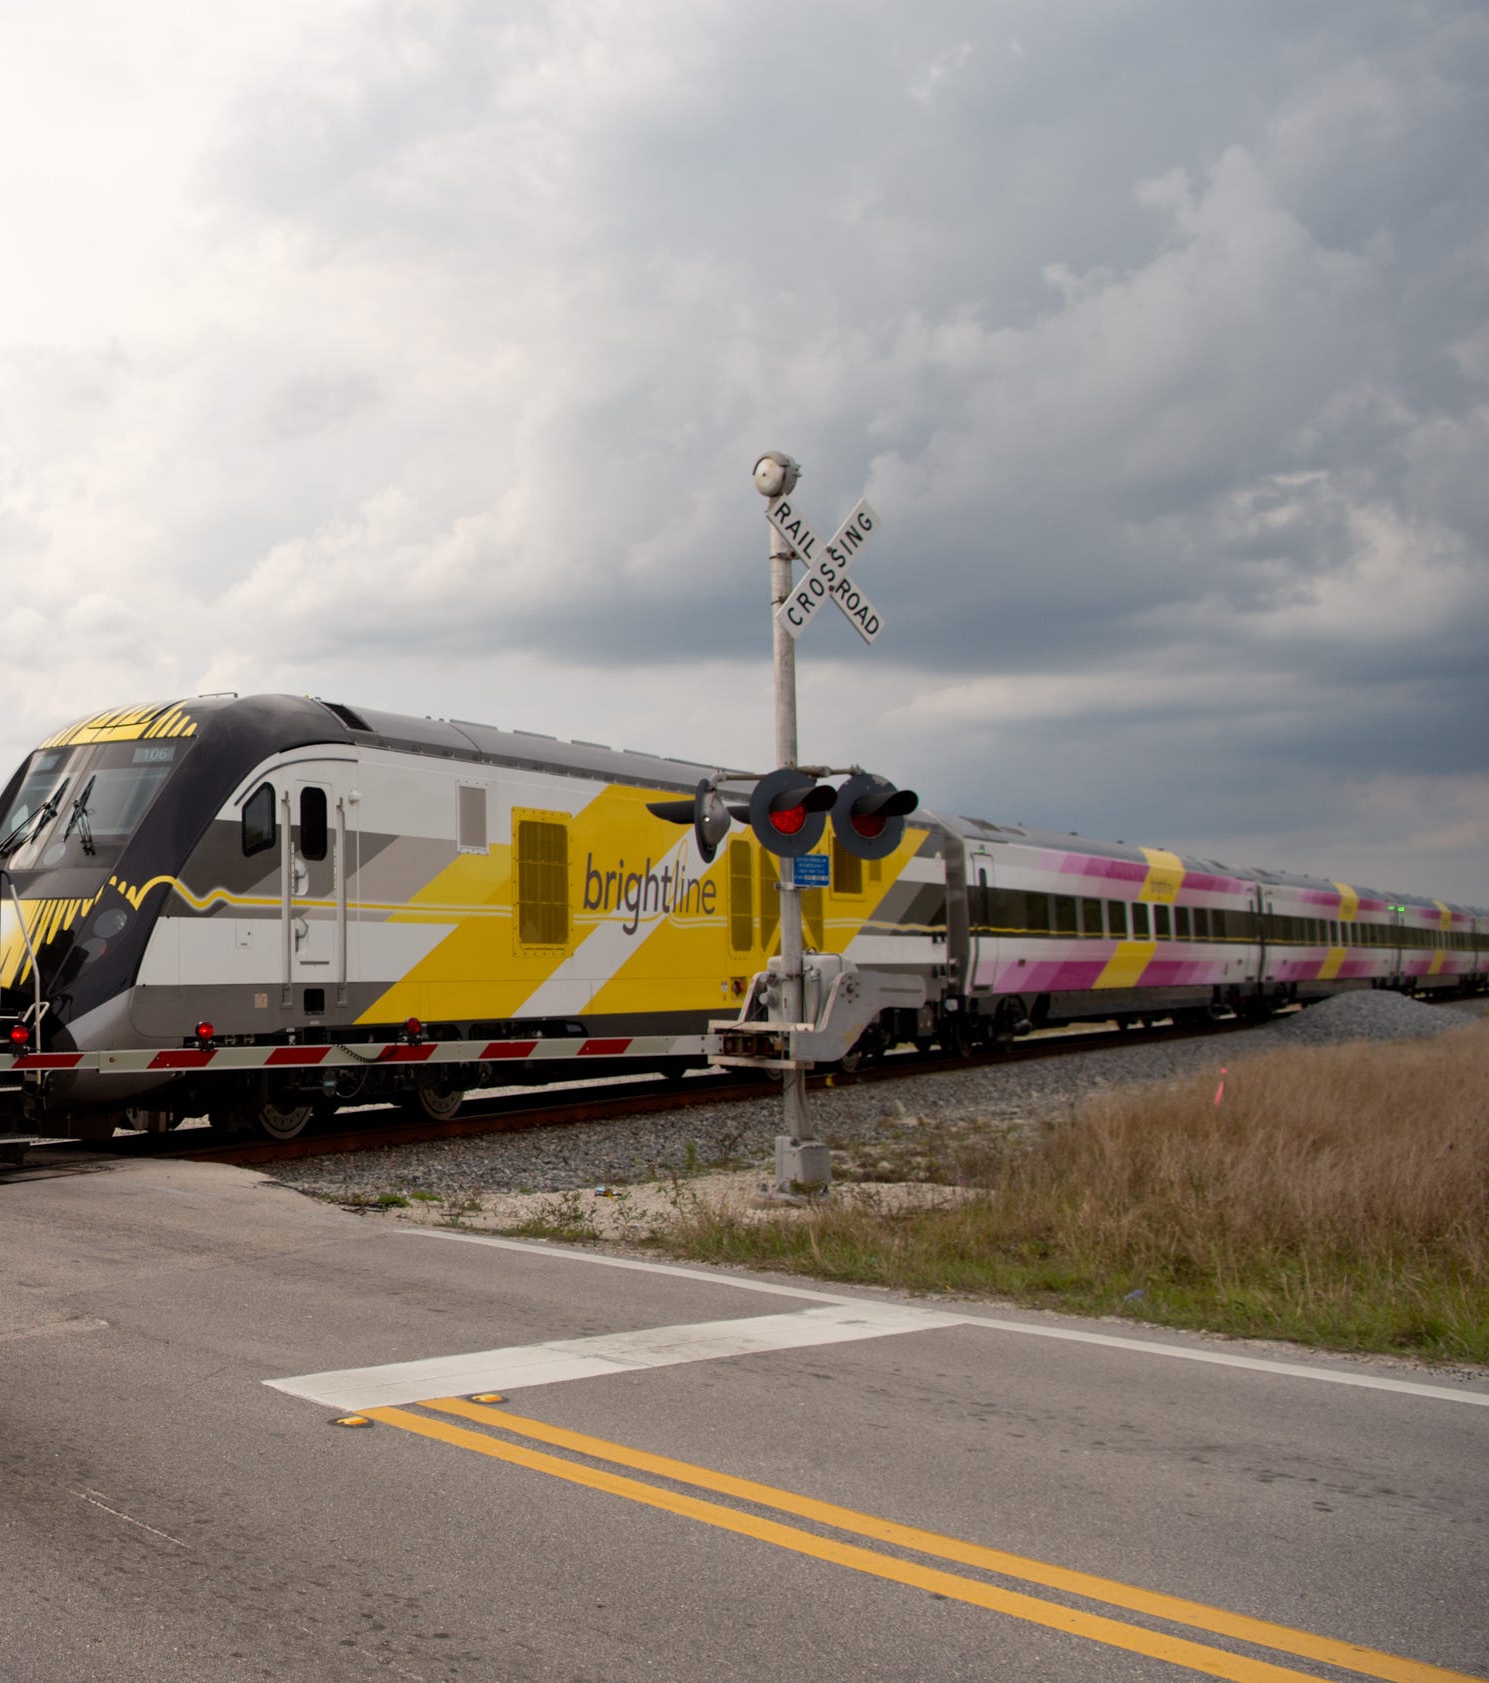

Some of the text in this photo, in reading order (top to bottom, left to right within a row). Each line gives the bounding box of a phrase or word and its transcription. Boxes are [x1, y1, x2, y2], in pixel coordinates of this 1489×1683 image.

[774, 502, 879, 635] RAIL ROAD
[787, 512, 872, 626] CROSSING
[143, 748, 167, 760] 106
[583, 852, 717, 936] brightline
